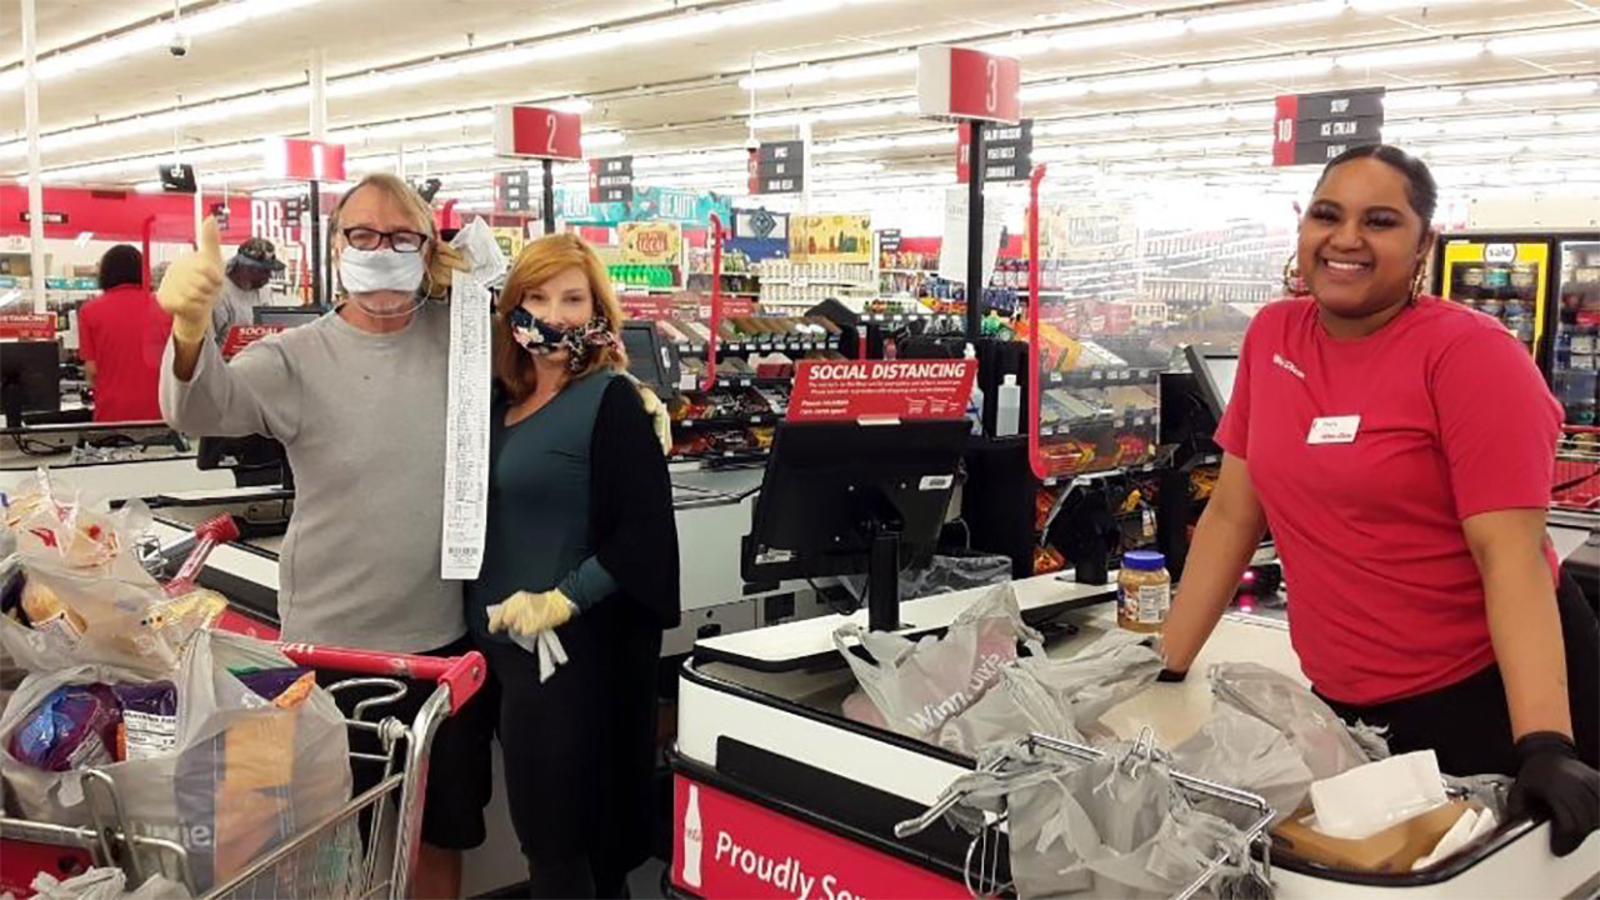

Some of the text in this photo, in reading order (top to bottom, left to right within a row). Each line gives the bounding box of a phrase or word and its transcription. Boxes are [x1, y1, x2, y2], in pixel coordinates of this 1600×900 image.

[986, 60, 998, 113] 3
[546, 114, 558, 154] 2
[1278, 118, 1293, 143] 10
[660, 193, 698, 219] BEAUTY
[1488, 246, 1512, 257] sale
[808, 363, 967, 380] SOCIAL DISTANCING
[908, 692, 967, 731] Winn
[715, 831, 815, 900] Proudly
